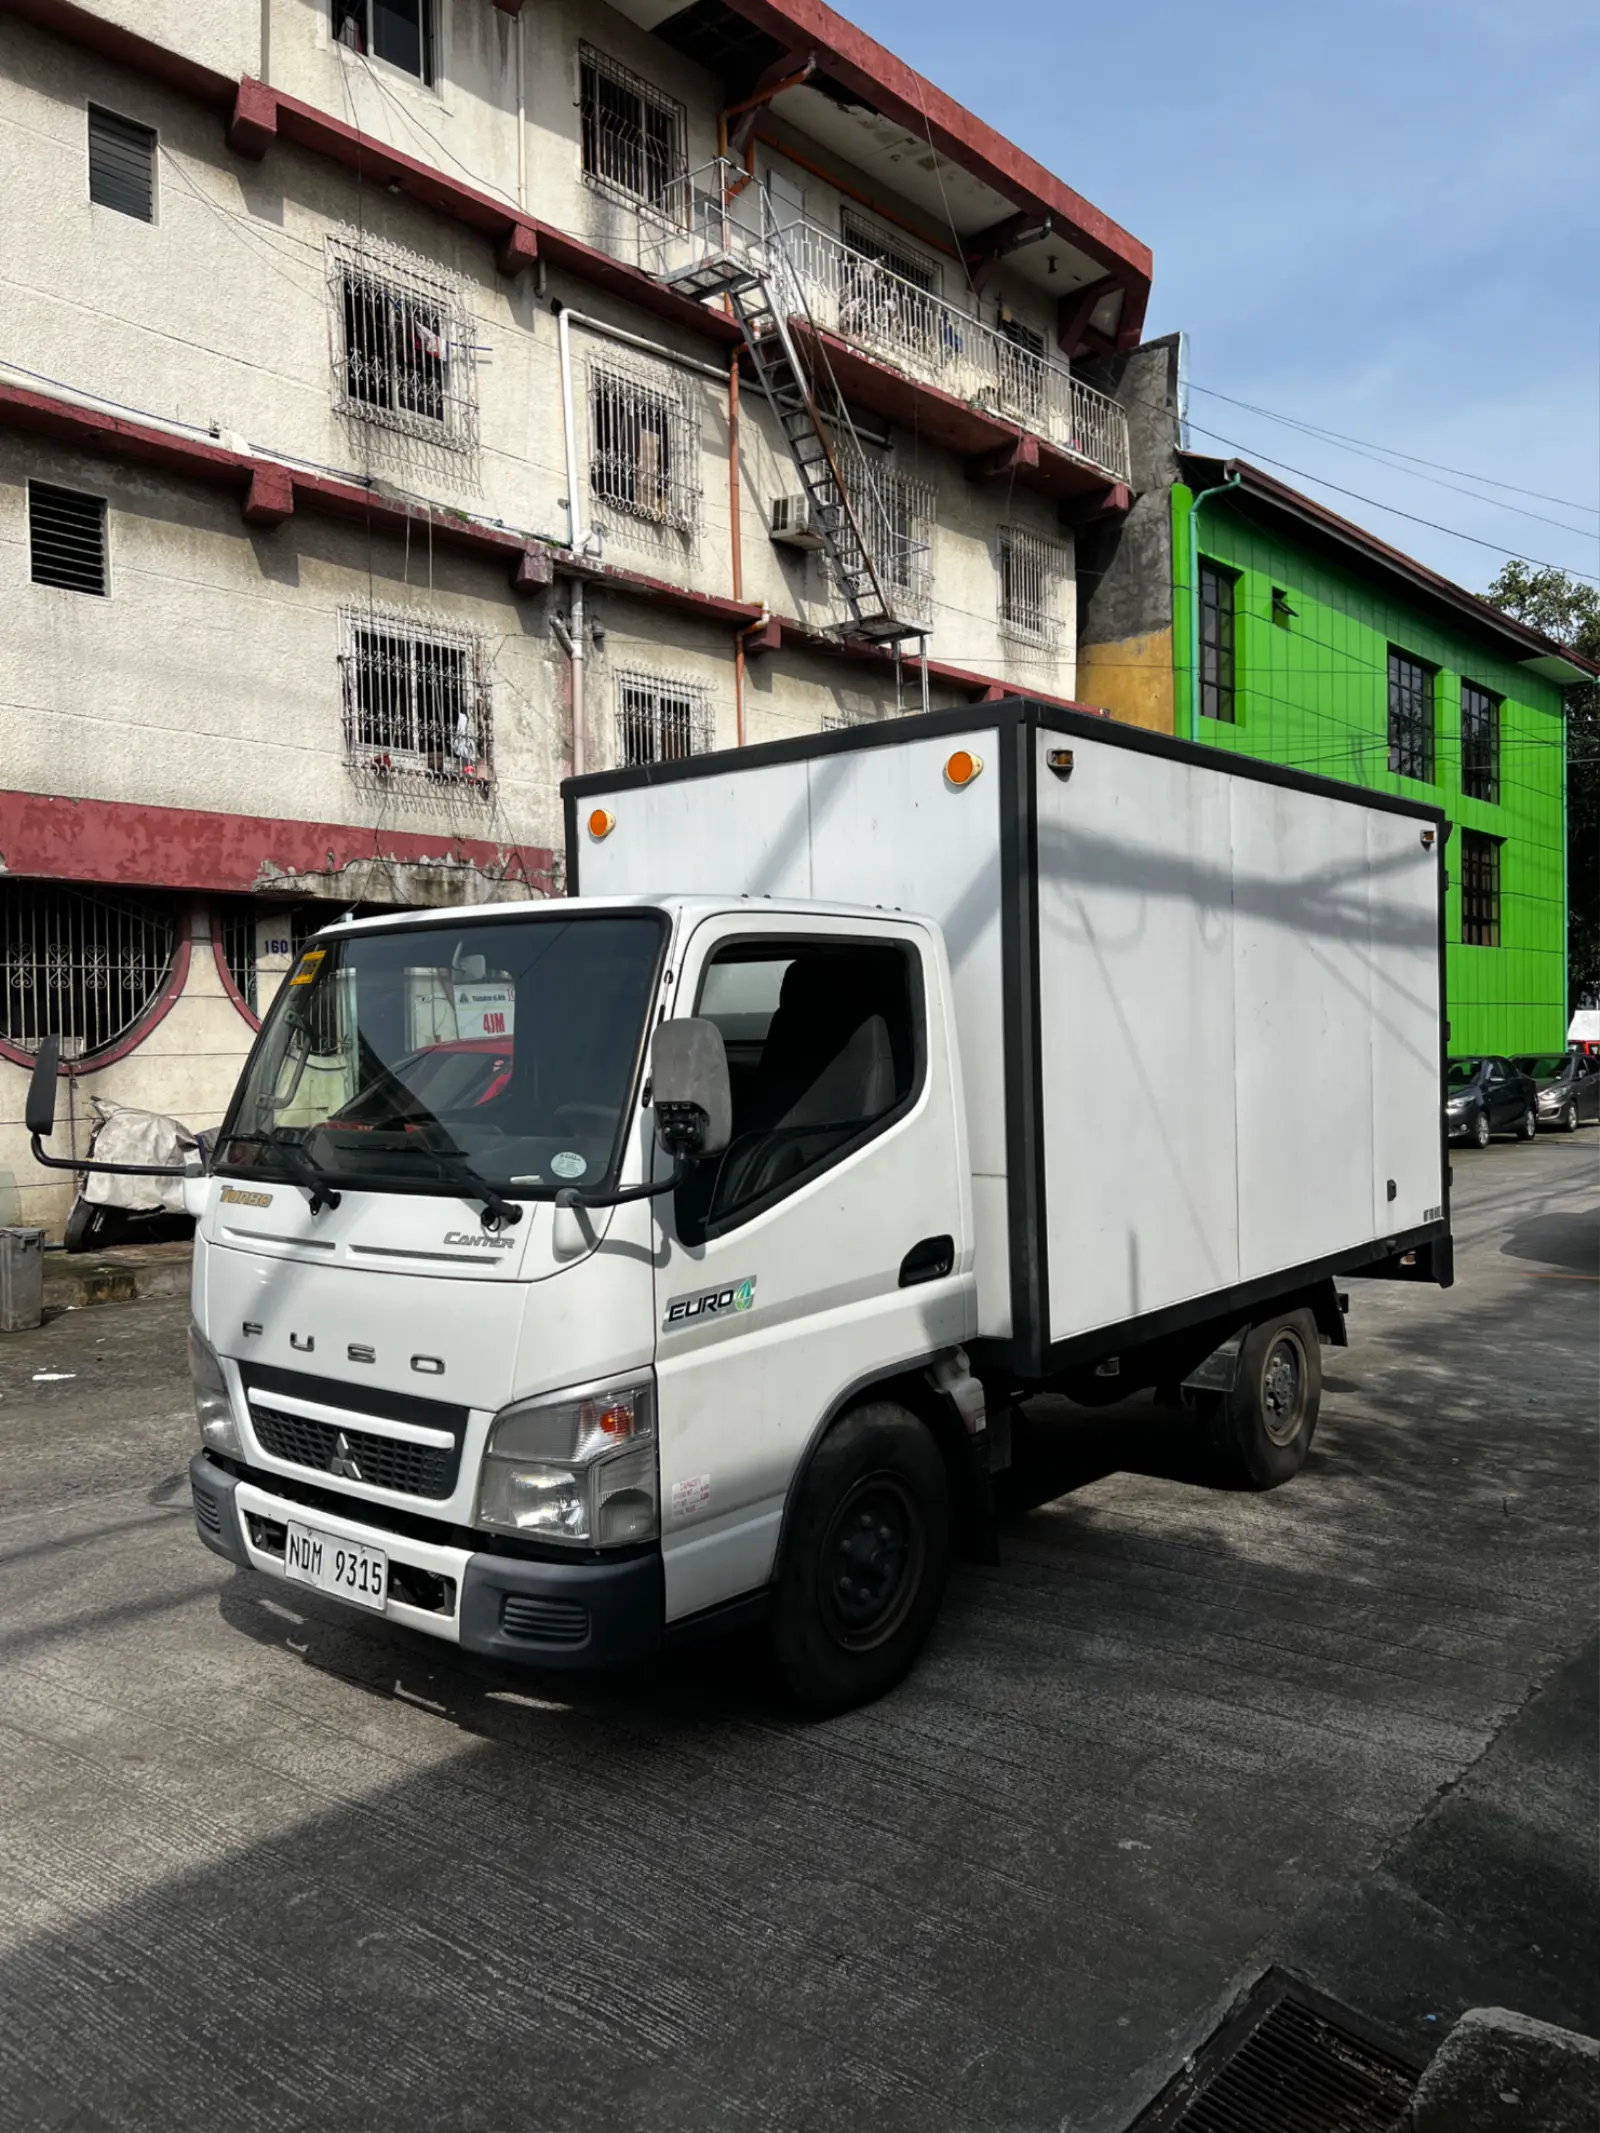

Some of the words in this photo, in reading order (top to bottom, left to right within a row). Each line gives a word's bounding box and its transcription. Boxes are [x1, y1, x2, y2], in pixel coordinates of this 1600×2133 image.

[265, 940, 288, 954] 160
[220, 1185, 273, 1208] TURBO
[443, 1232, 515, 1248] CANTER
[242, 1321, 446, 1375] FUSO
[289, 1534, 323, 1575] NDM
[335, 1550, 382, 1595] 9315
